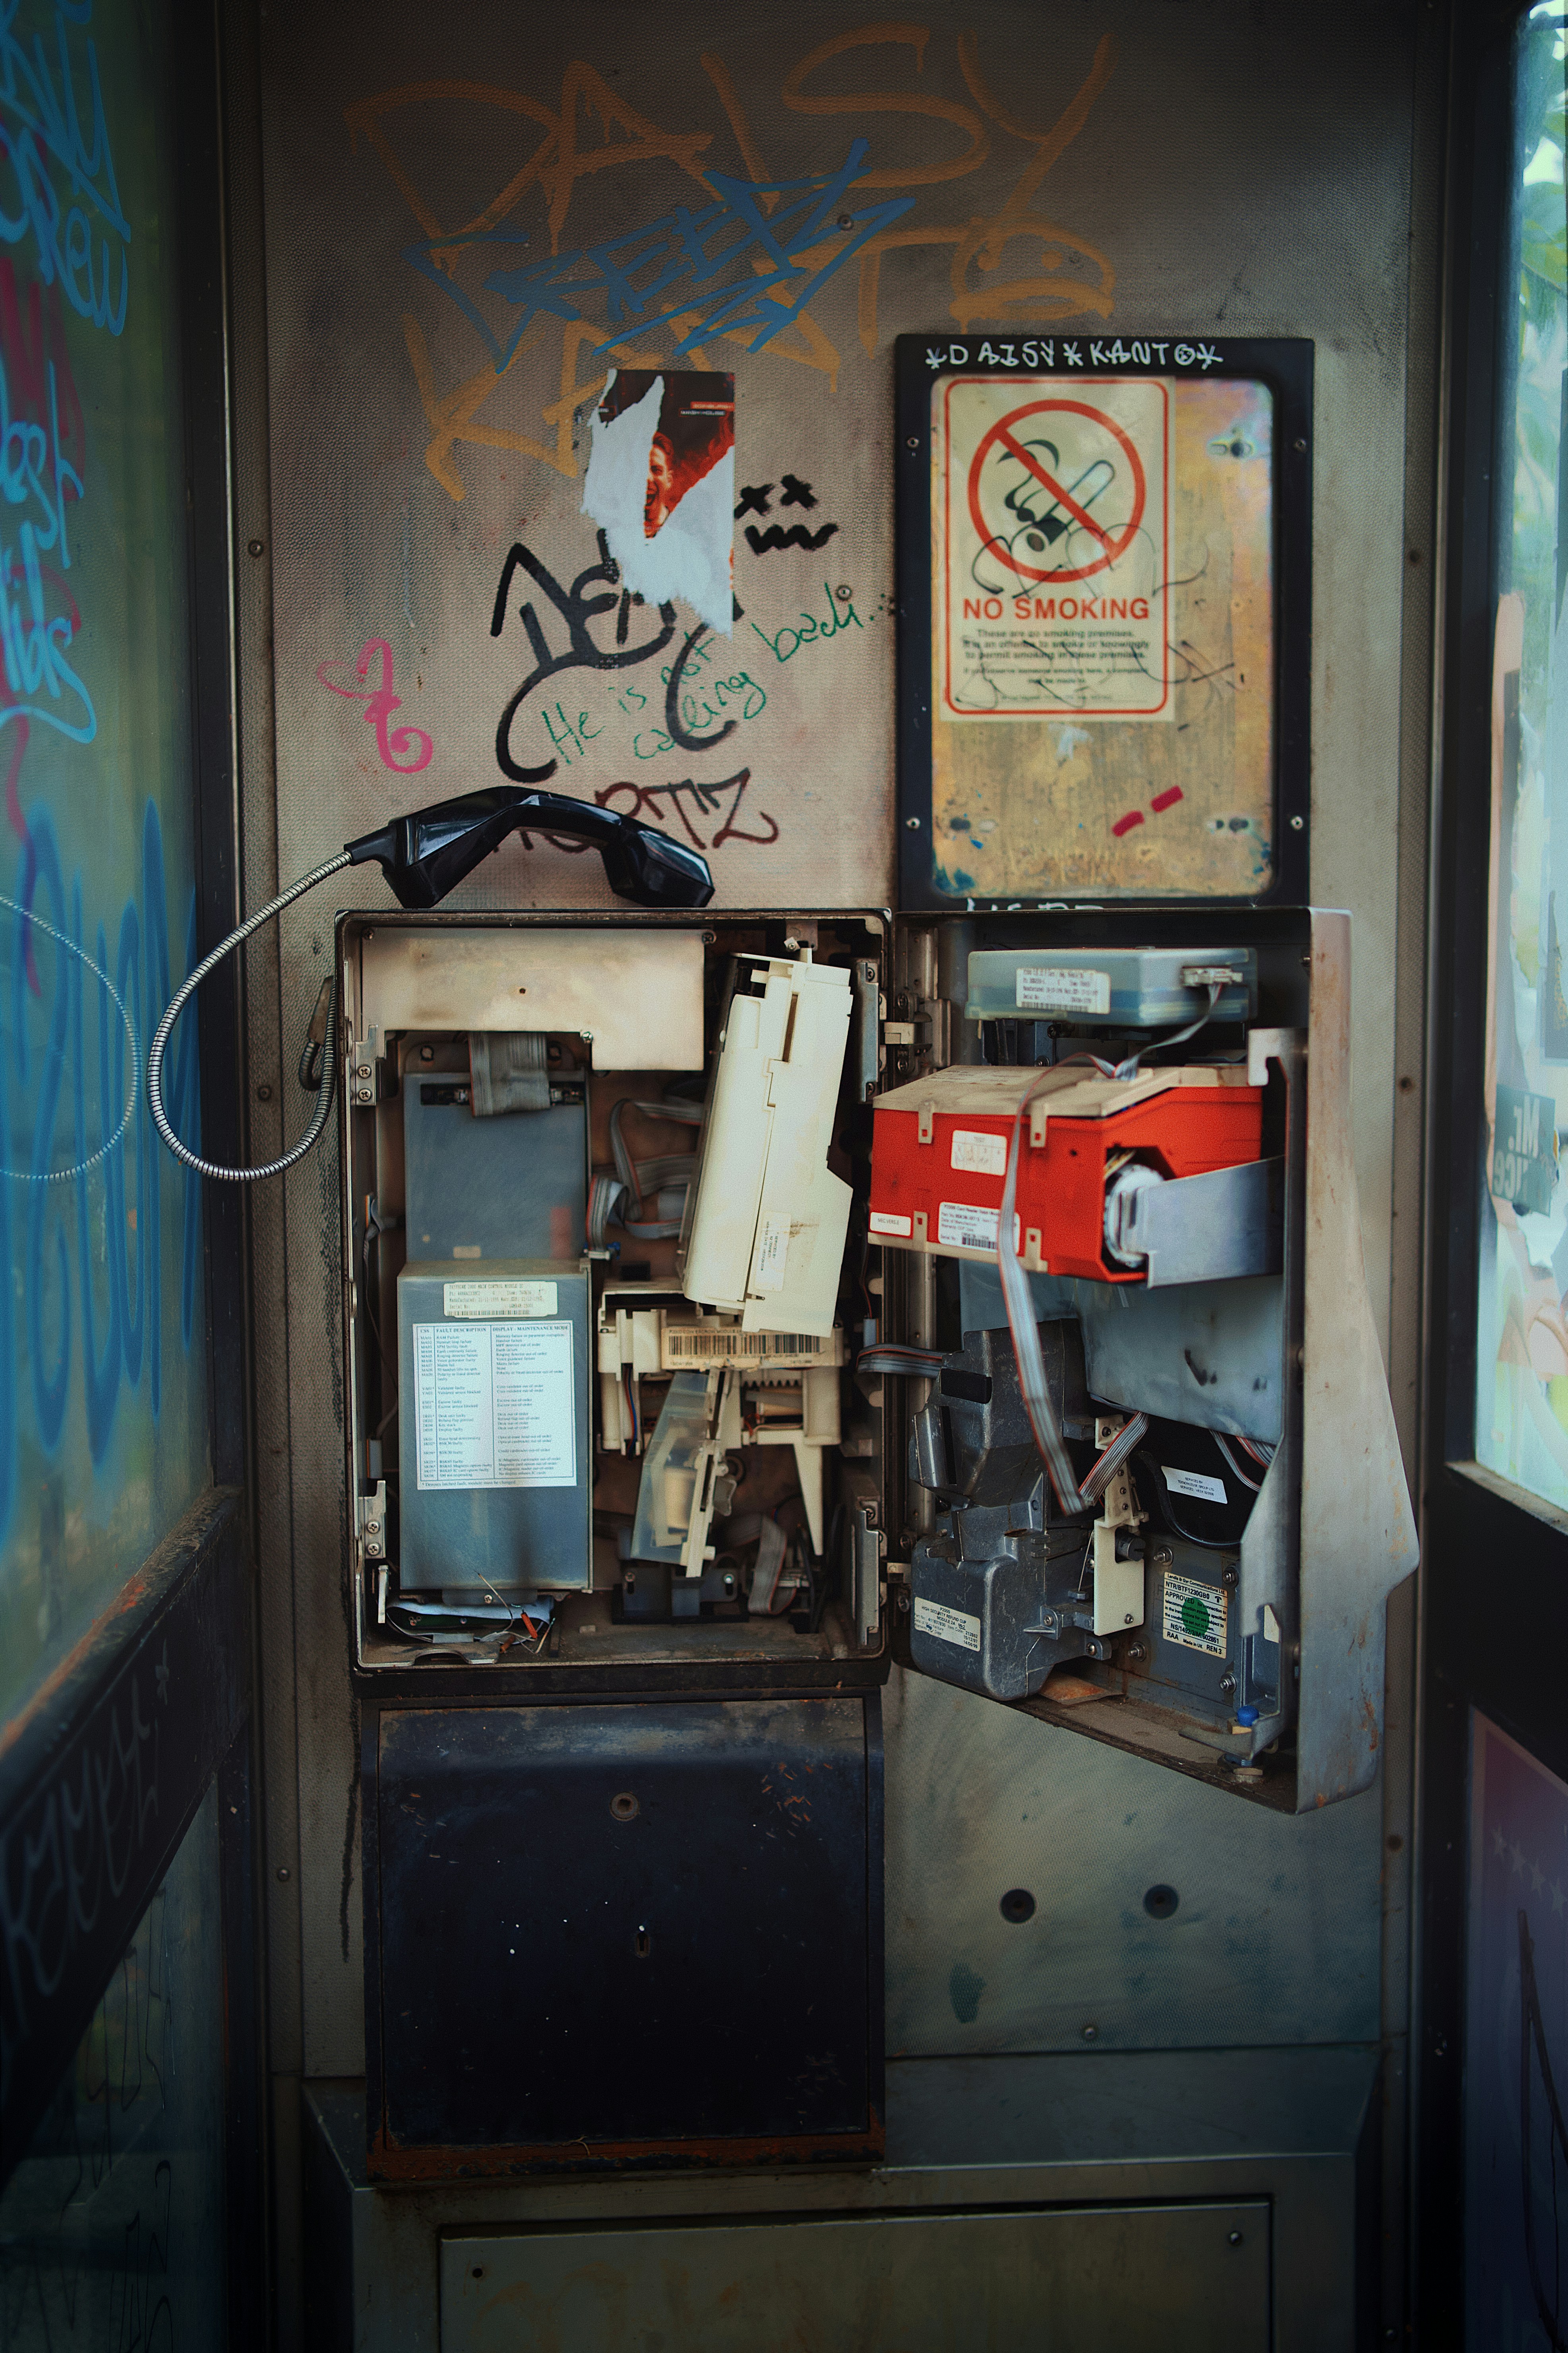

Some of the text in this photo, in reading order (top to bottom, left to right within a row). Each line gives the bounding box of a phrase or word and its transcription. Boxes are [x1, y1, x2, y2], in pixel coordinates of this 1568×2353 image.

[963, 597, 1150, 620] NO SMOKING
[1044, 629, 1084, 638] smoking
[543, 703, 605, 764] He
[1189, 1580, 1218, 1593] Communications
[1165, 1591, 1194, 1604] APPROVED
[1203, 1605, 1222, 1613] connection
[930, 1609, 945, 1617] SECURITY
[946, 1613, 959, 1622] REFUND
[1167, 1631, 1179, 1640] RAA
[1206, 1644, 1218, 1653] REN
